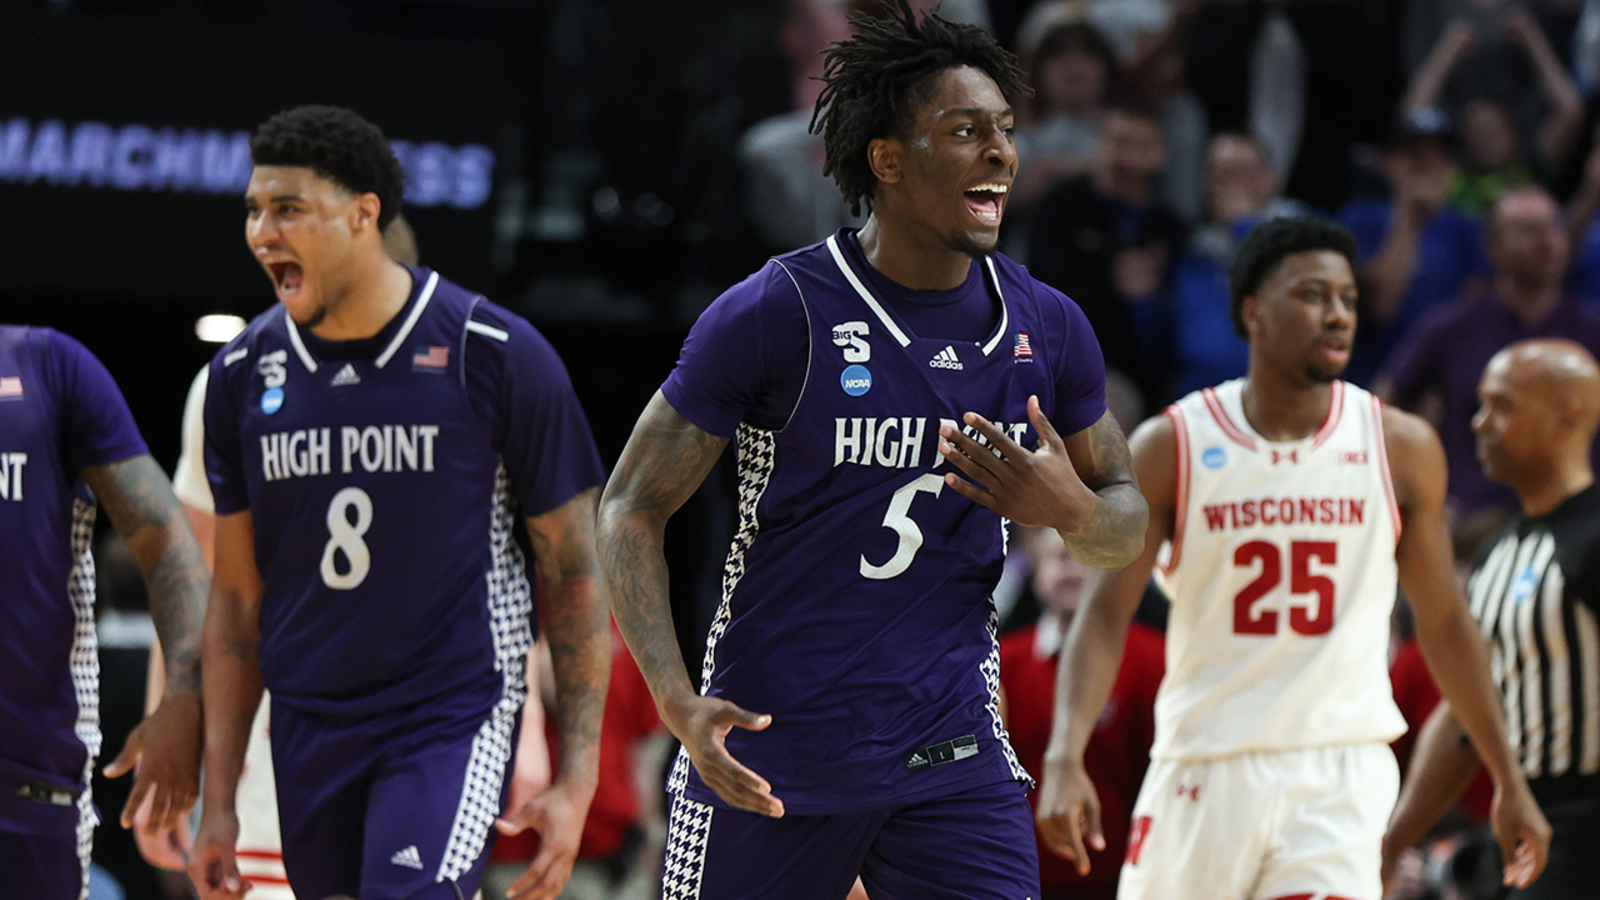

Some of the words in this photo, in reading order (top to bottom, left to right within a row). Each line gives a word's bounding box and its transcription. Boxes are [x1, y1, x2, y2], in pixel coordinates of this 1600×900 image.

[845, 379, 871, 389] NCAA
[929, 359, 964, 371] adidas
[260, 427, 331, 482] HIGH
[341, 425, 440, 474] POINT
[833, 417, 927, 469] HIGH
[320, 486, 373, 590] 8
[859, 473, 945, 580] 5
[1203, 496, 1366, 532] WISCONSIN
[1233, 540, 1337, 636] 25
